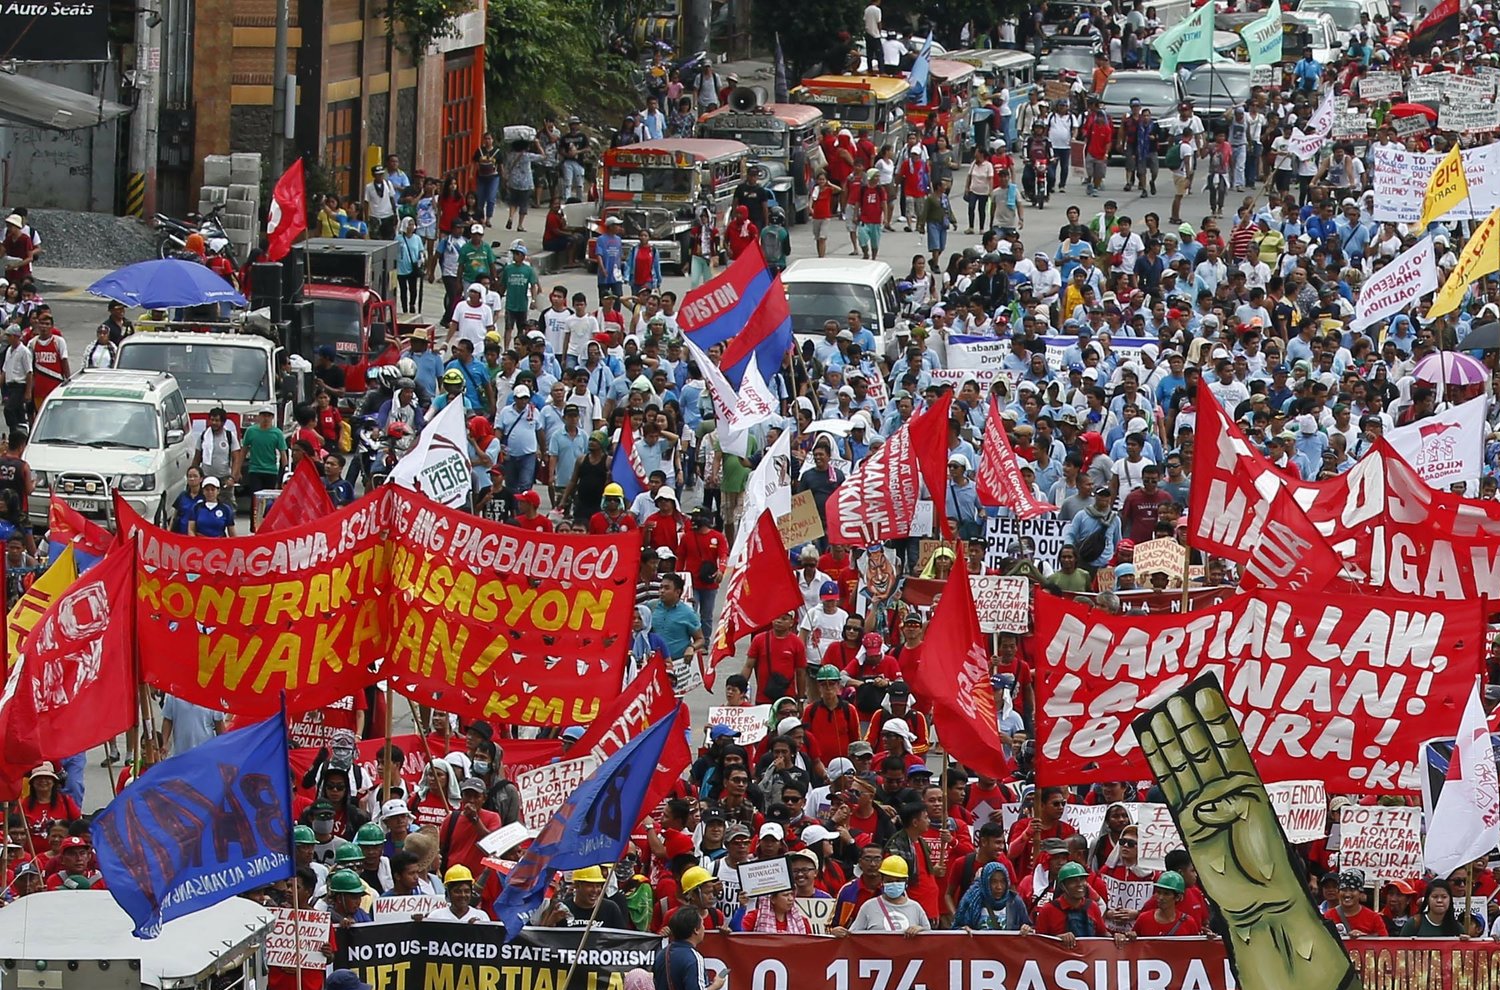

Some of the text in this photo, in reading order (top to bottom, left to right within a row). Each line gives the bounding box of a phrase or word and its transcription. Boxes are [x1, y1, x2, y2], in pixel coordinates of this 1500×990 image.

[5, 2, 94, 16] Auto Seats
[682, 282, 740, 328] PISTON
[966, 343, 1005, 353] Labanan
[990, 519, 1067, 537] JEEPNEY
[408, 508, 619, 581] ANG PAGBABAGO
[1135, 563, 1184, 573] WAKASAN
[1046, 596, 1448, 680] MARTIAL LAW,
[483, 691, 601, 725] KMU
[716, 706, 744, 717] STOP
[550, 762, 585, 782] 174
[1277, 784, 1326, 804] TO ENDO!
[1287, 808, 1327, 831] NMW!
[1374, 812, 1412, 827] 174
[1360, 827, 1418, 839] KONTRA-
[1341, 853, 1418, 869] IBASURA!
[375, 898, 433, 914] WAKASAN
[299, 926, 325, 938] DAILY
[348, 939, 656, 967] NO TO US-BACKED STATE-TERRORISM!
